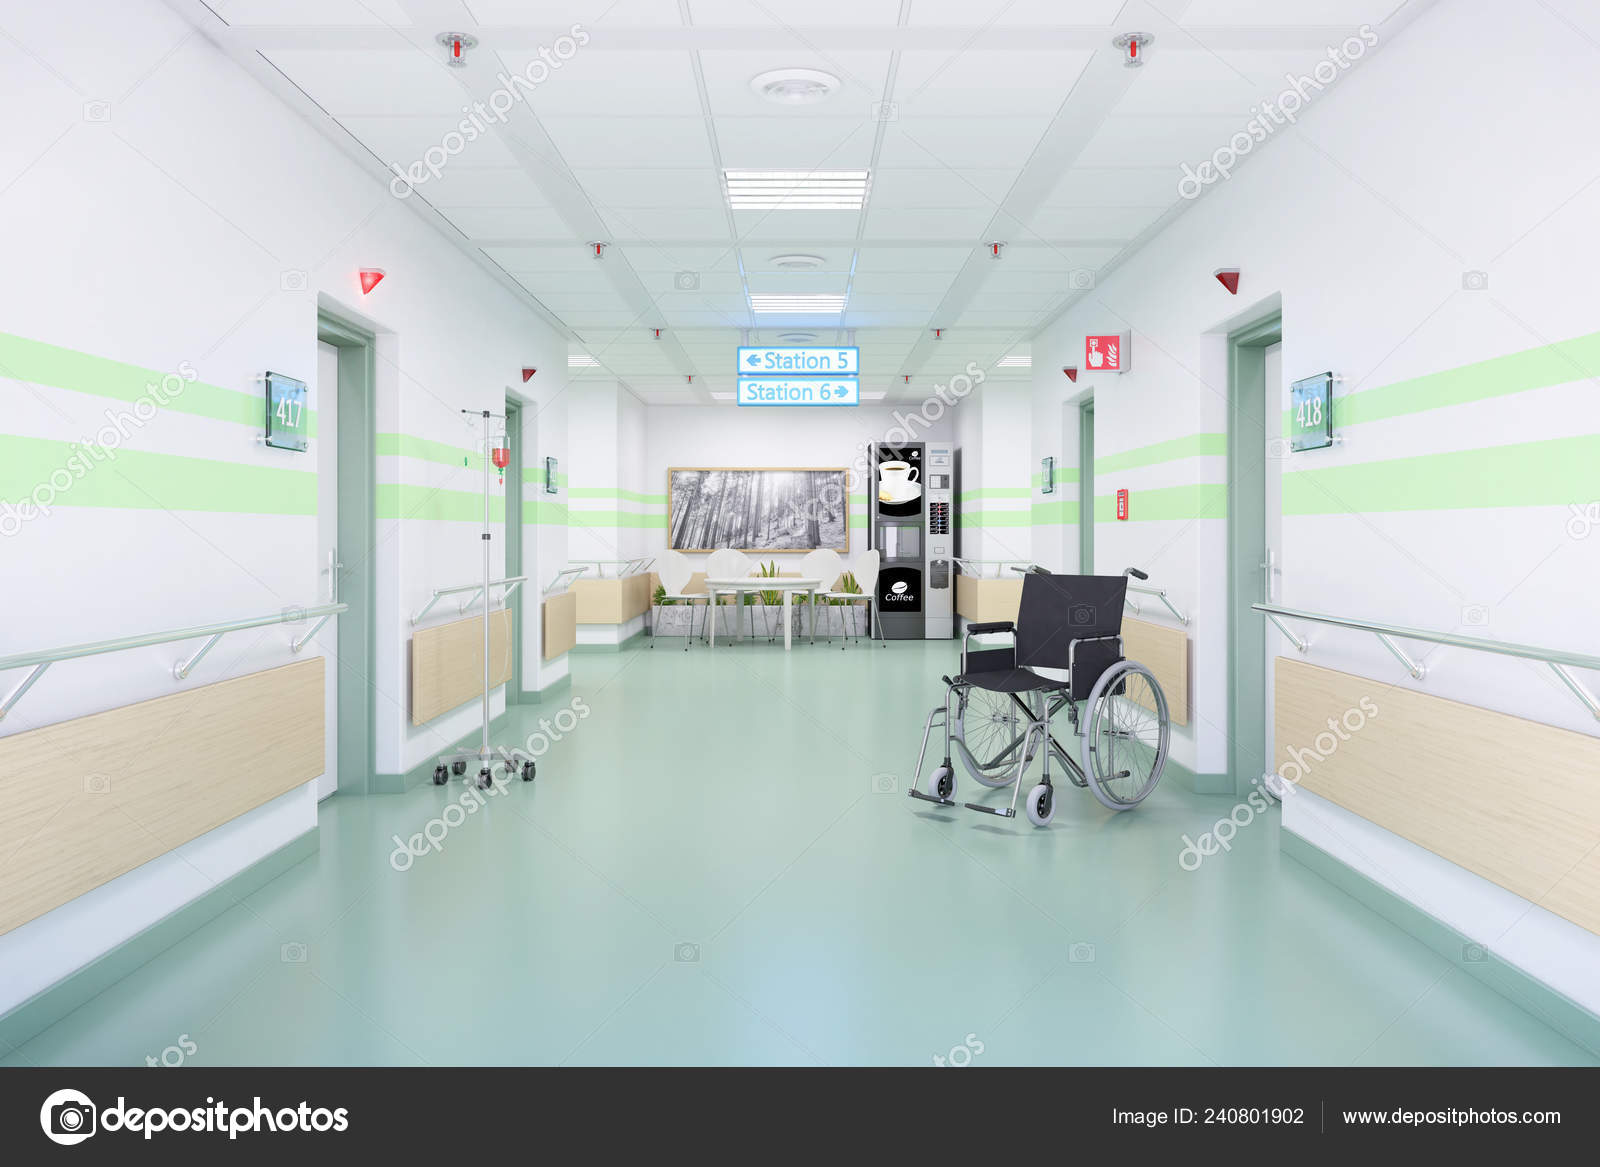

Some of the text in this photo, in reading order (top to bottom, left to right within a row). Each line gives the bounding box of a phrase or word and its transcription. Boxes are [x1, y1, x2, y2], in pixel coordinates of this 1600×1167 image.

[764, 352, 848, 369] Station 5
[746, 383, 831, 401] Station 6
[276, 397, 302, 428] 417
[1296, 396, 1322, 428] 418
[885, 593, 914, 602] Coffee
